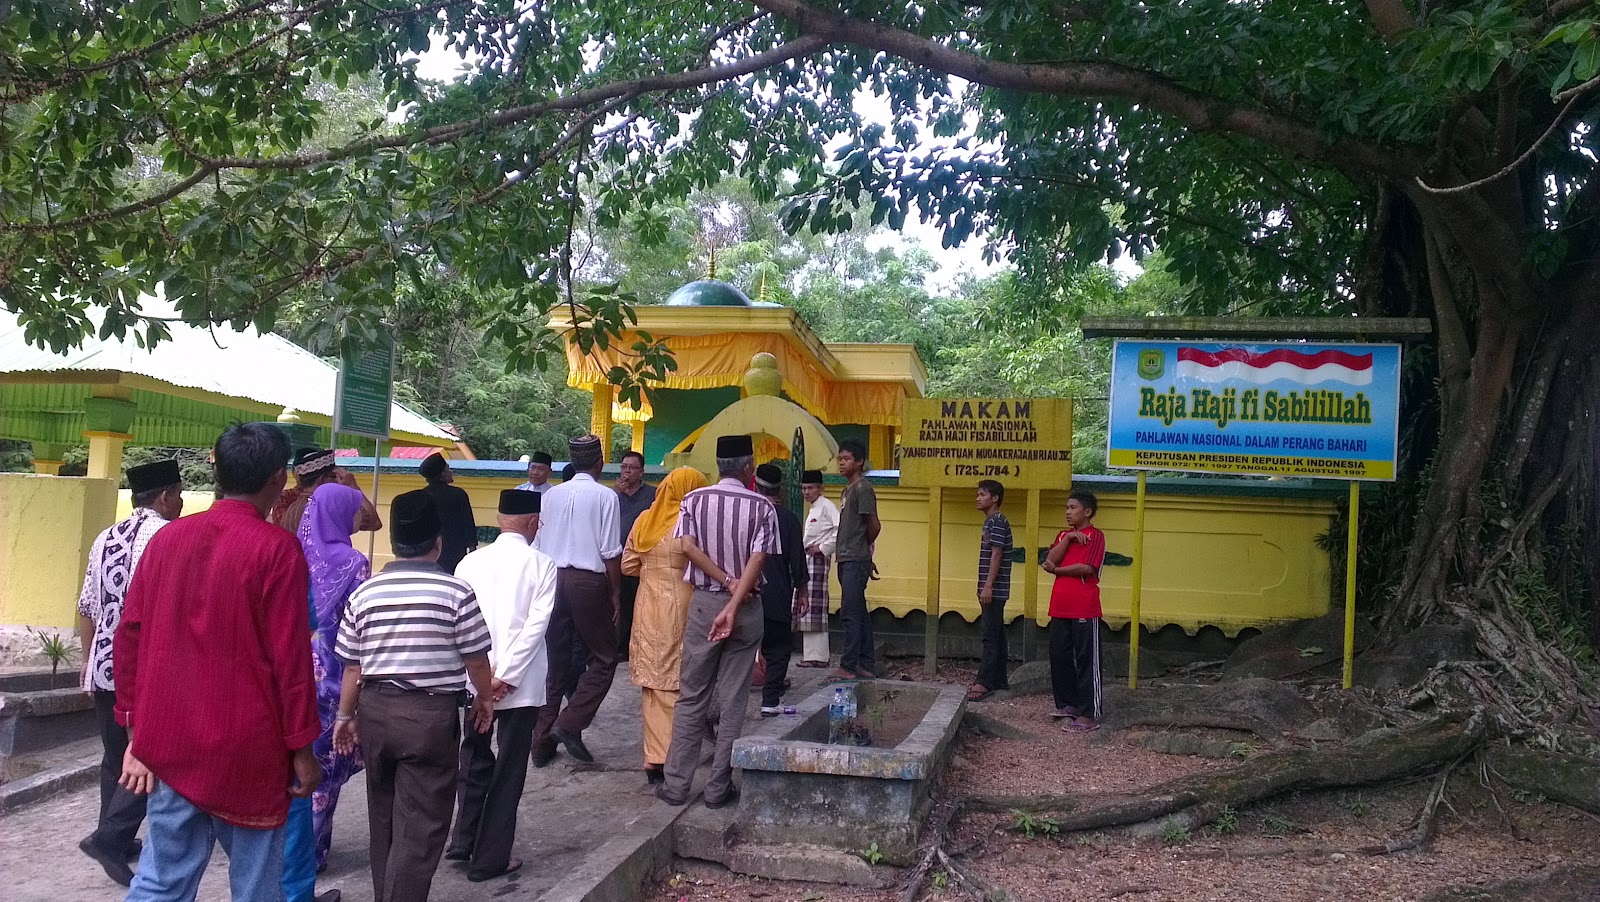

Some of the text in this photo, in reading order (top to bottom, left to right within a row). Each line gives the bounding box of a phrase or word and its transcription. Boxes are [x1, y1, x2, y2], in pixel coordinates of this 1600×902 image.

[942, 401, 1030, 419] MAKAM
[1140, 387, 1371, 427] Raja Haji fi Sabilillah
[921, 419, 1036, 431] PAHLAWAN NASIONAL
[919, 430, 1037, 442] RAJA HAJI FISABILILLAH
[1136, 431, 1367, 452] PAHLAWAN NASIONAL DALAM PERANG BAHARI
[1136, 451, 1365, 469] KEPUTUSAN PRESIDEN REPUBLIK INDONESIA
